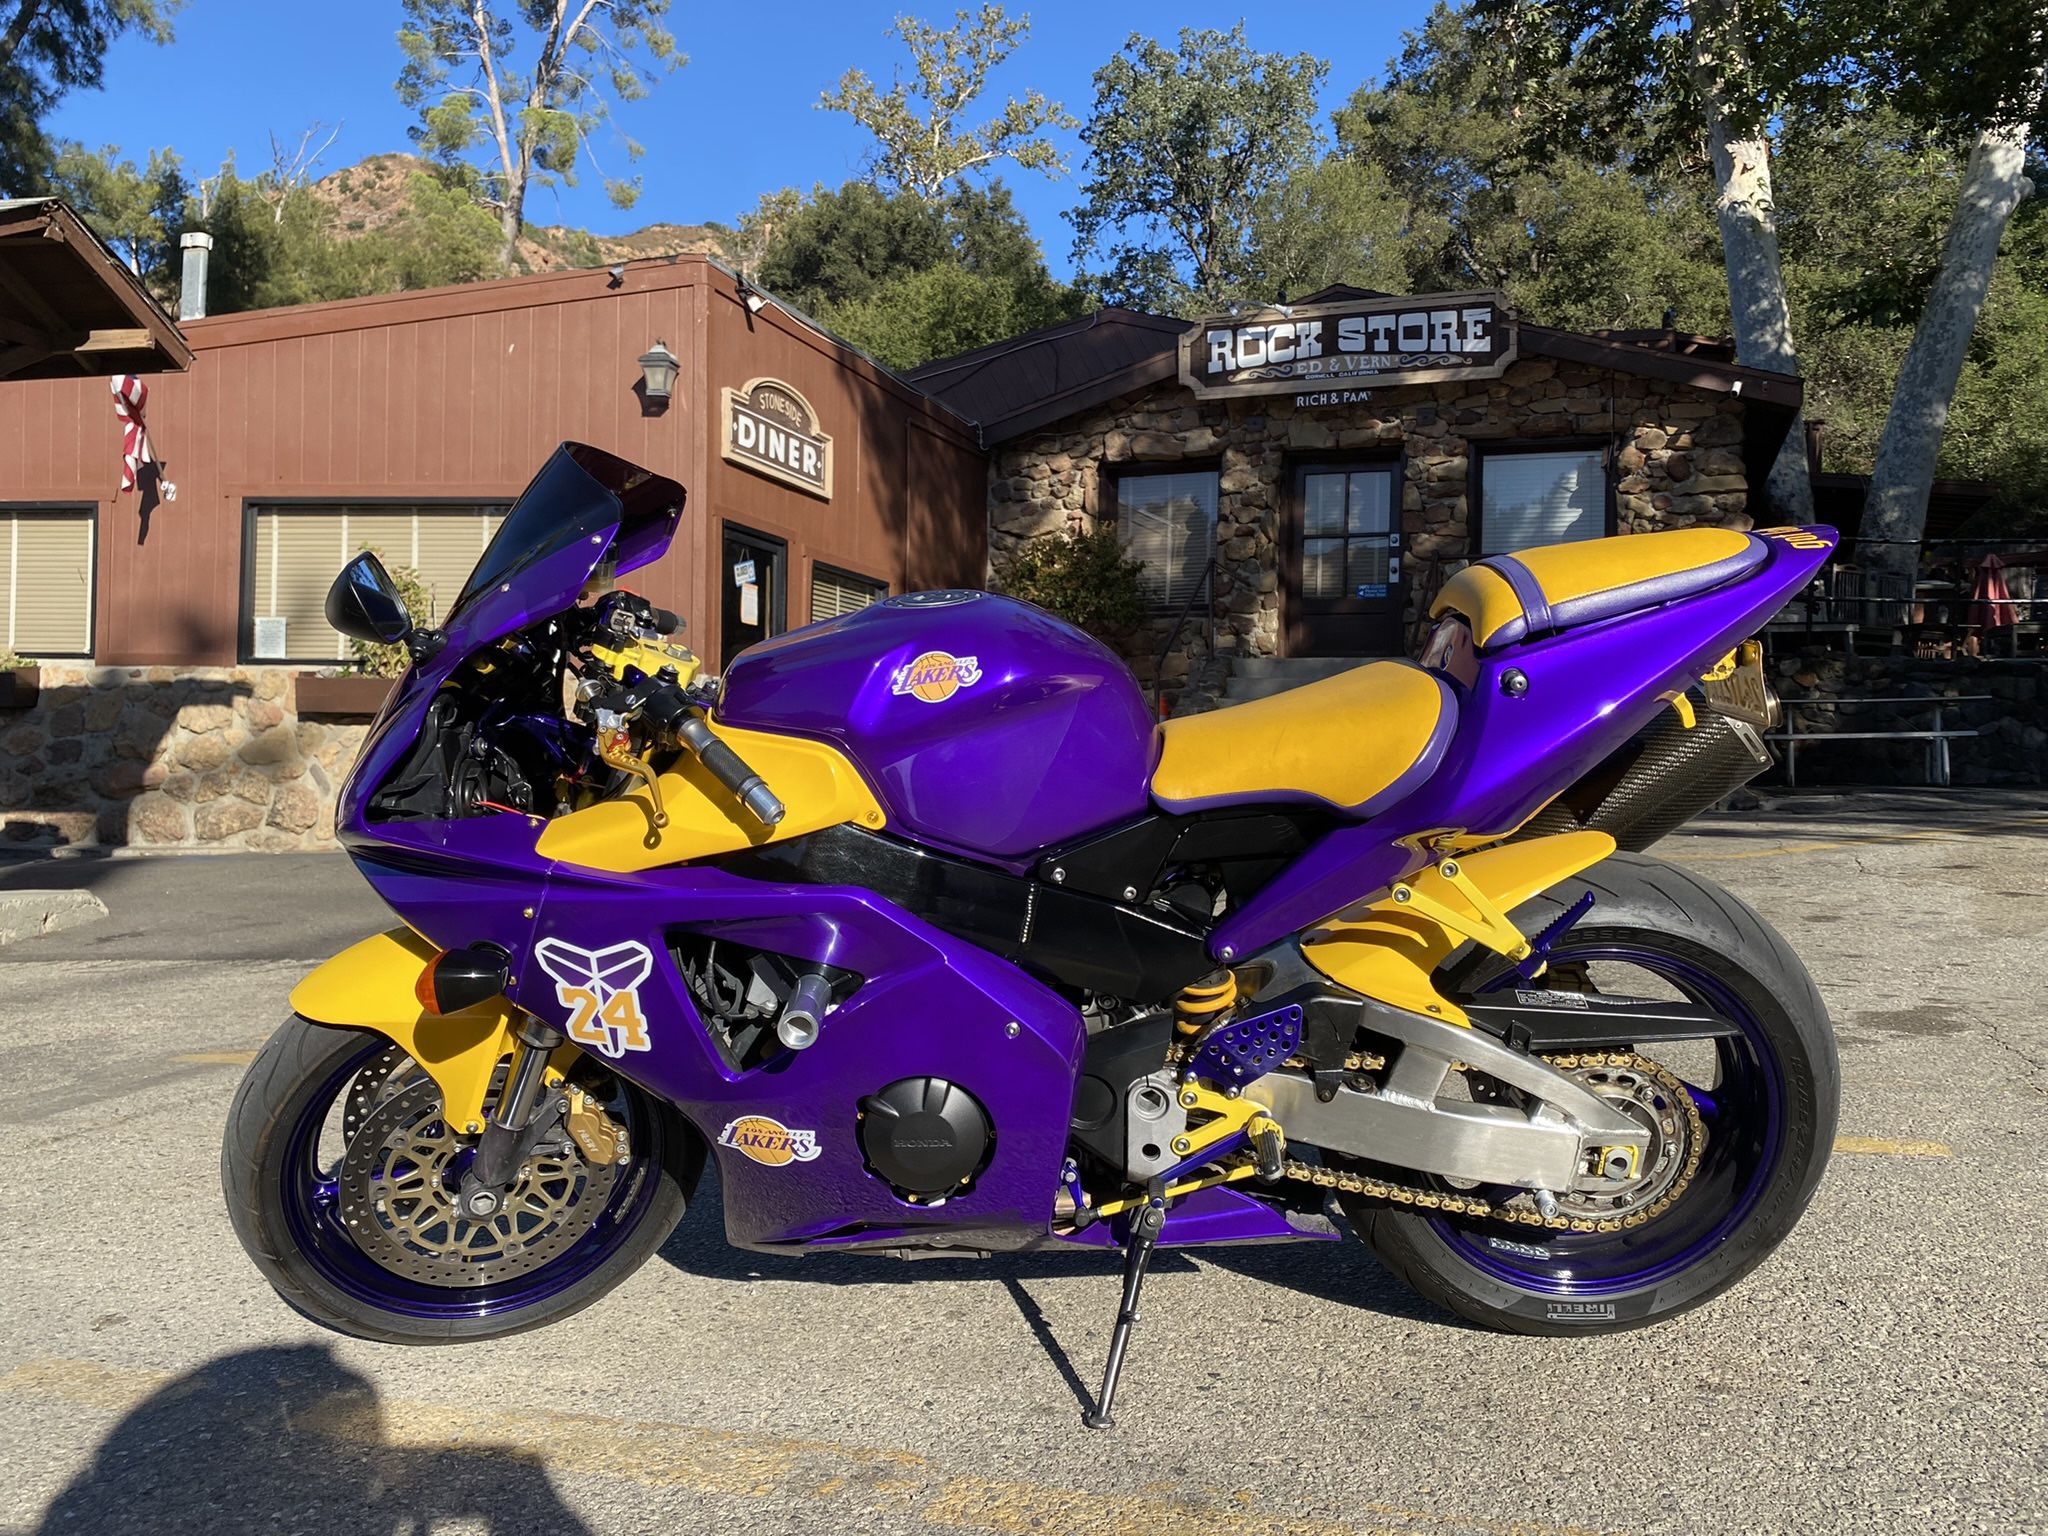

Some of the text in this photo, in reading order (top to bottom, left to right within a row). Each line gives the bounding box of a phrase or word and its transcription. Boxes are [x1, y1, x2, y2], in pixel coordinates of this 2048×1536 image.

[1207, 308, 1492, 374] ROCK STORE
[1296, 354, 1391, 374] ED & VERN
[1339, 369, 1379, 377] CALIFORNIA
[760, 393, 802, 427] STONESIDE
[1296, 393, 1328, 407] RICH
[1330, 392, 1339, 404] &
[738, 414, 816, 476] DINER
[899, 662, 976, 692] LAKERS
[561, 987, 645, 1046] 24
[726, 1126, 811, 1155] LAKERS
[765, 1129, 811, 1137] ANGELES
[894, 1139, 953, 1148] HONDA
[1546, 1303, 1616, 1320] PIRELLI
